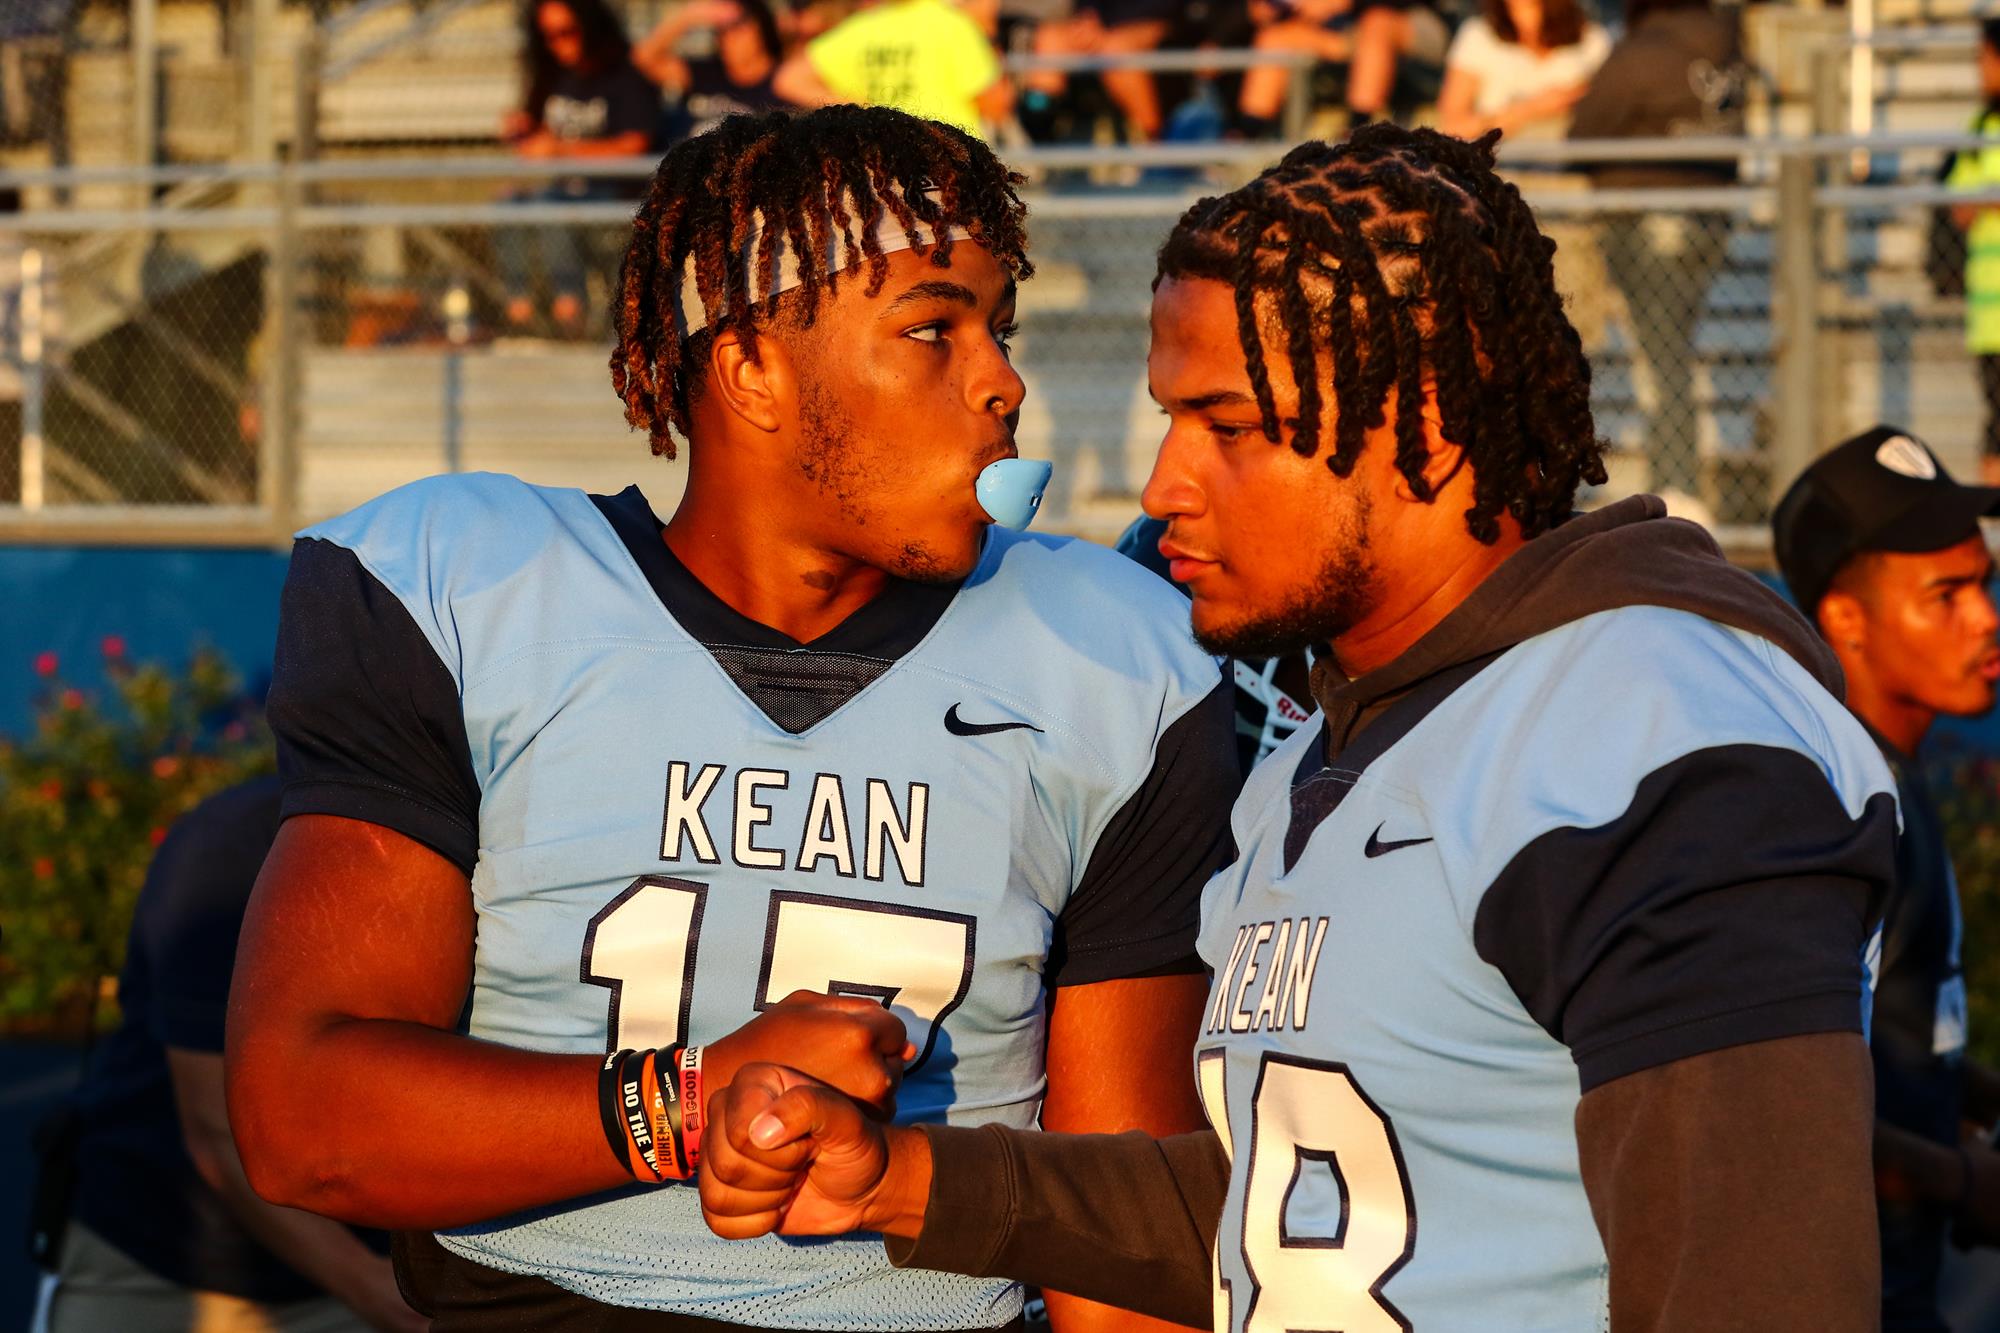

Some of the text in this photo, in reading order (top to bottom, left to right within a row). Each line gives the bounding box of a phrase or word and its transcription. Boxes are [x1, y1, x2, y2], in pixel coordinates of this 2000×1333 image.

[659, 761, 929, 887] KEAN
[580, 874, 977, 1076] 17
[1207, 916, 1330, 1035] KEAN
[624, 1081, 639, 1108] DO
[628, 1110, 651, 1147] THE
[685, 1046, 698, 1112] GOOD LUC
[1198, 1047, 1418, 1333] 8
